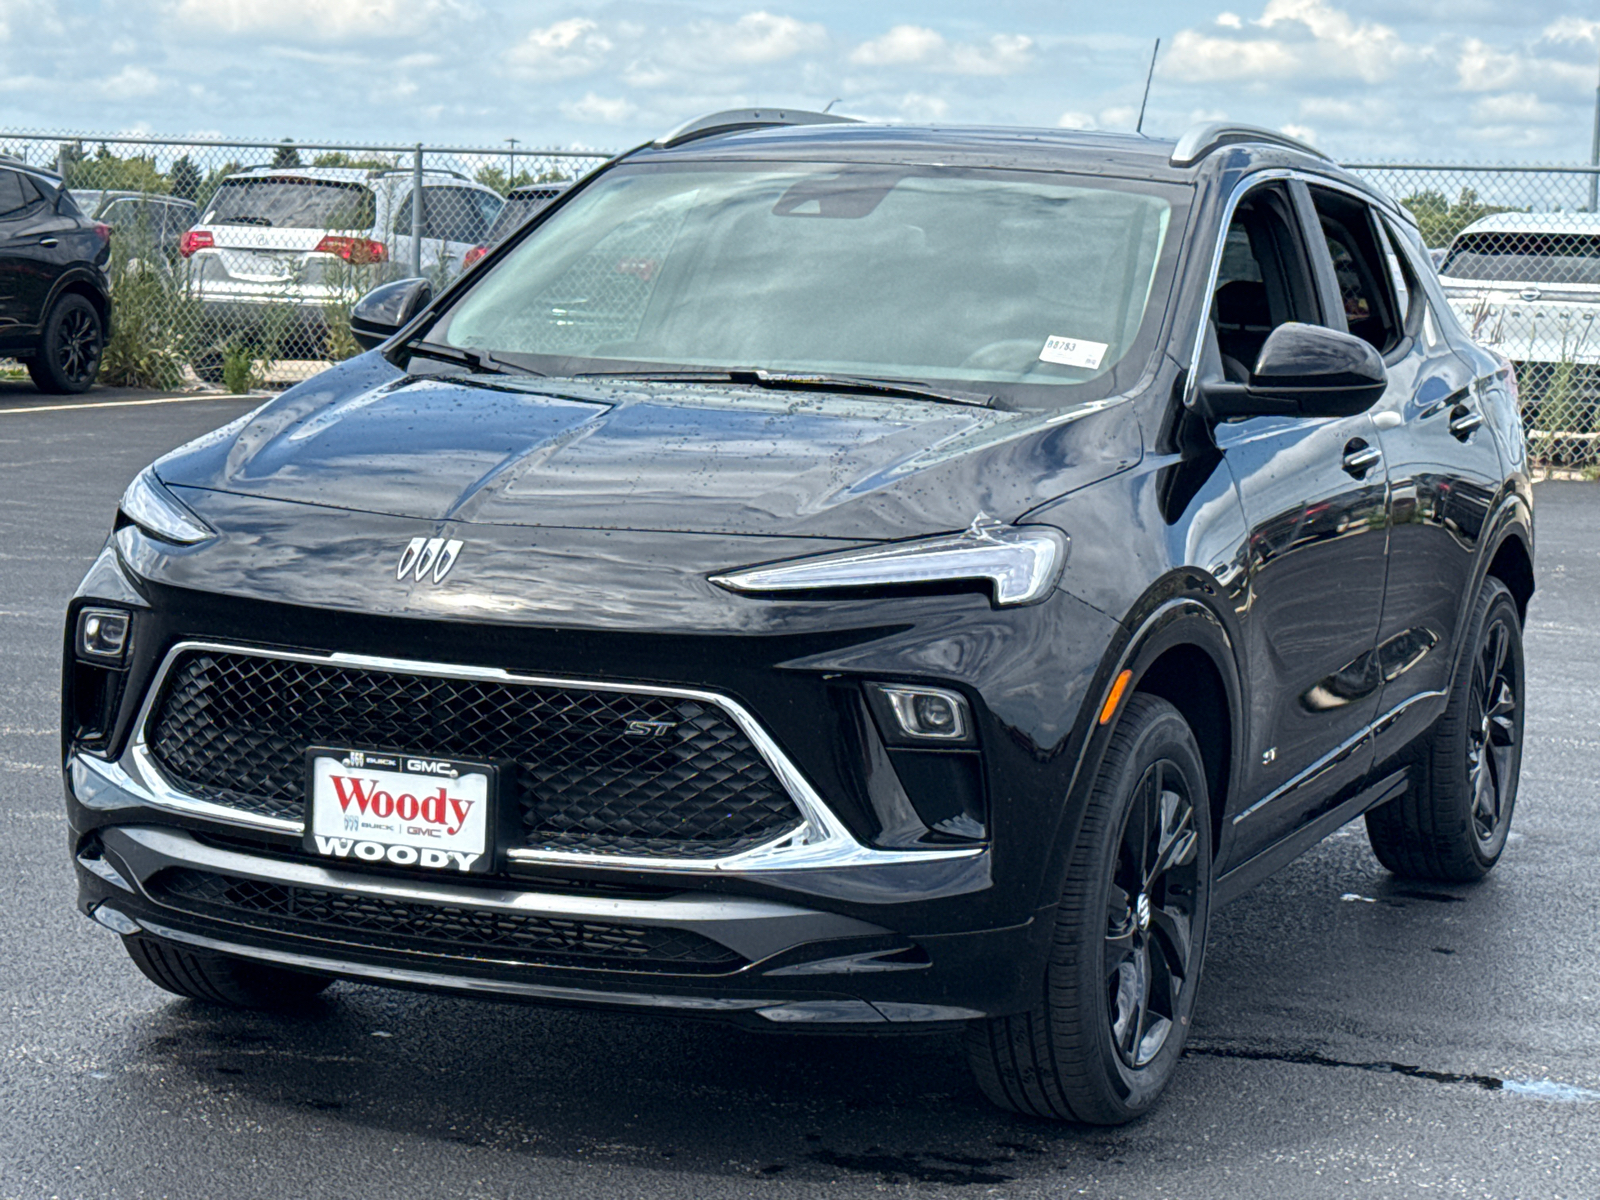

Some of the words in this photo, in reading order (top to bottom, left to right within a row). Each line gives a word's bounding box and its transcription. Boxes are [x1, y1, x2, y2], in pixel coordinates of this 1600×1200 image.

[624, 720, 677, 736] ST
[366, 757, 397, 767] BUICK
[407, 759, 451, 775] GMC
[329, 775, 475, 835] Woody
[361, 822, 394, 831] BUICK
[407, 826, 442, 838] GMC
[315, 835, 480, 871] WOODY
